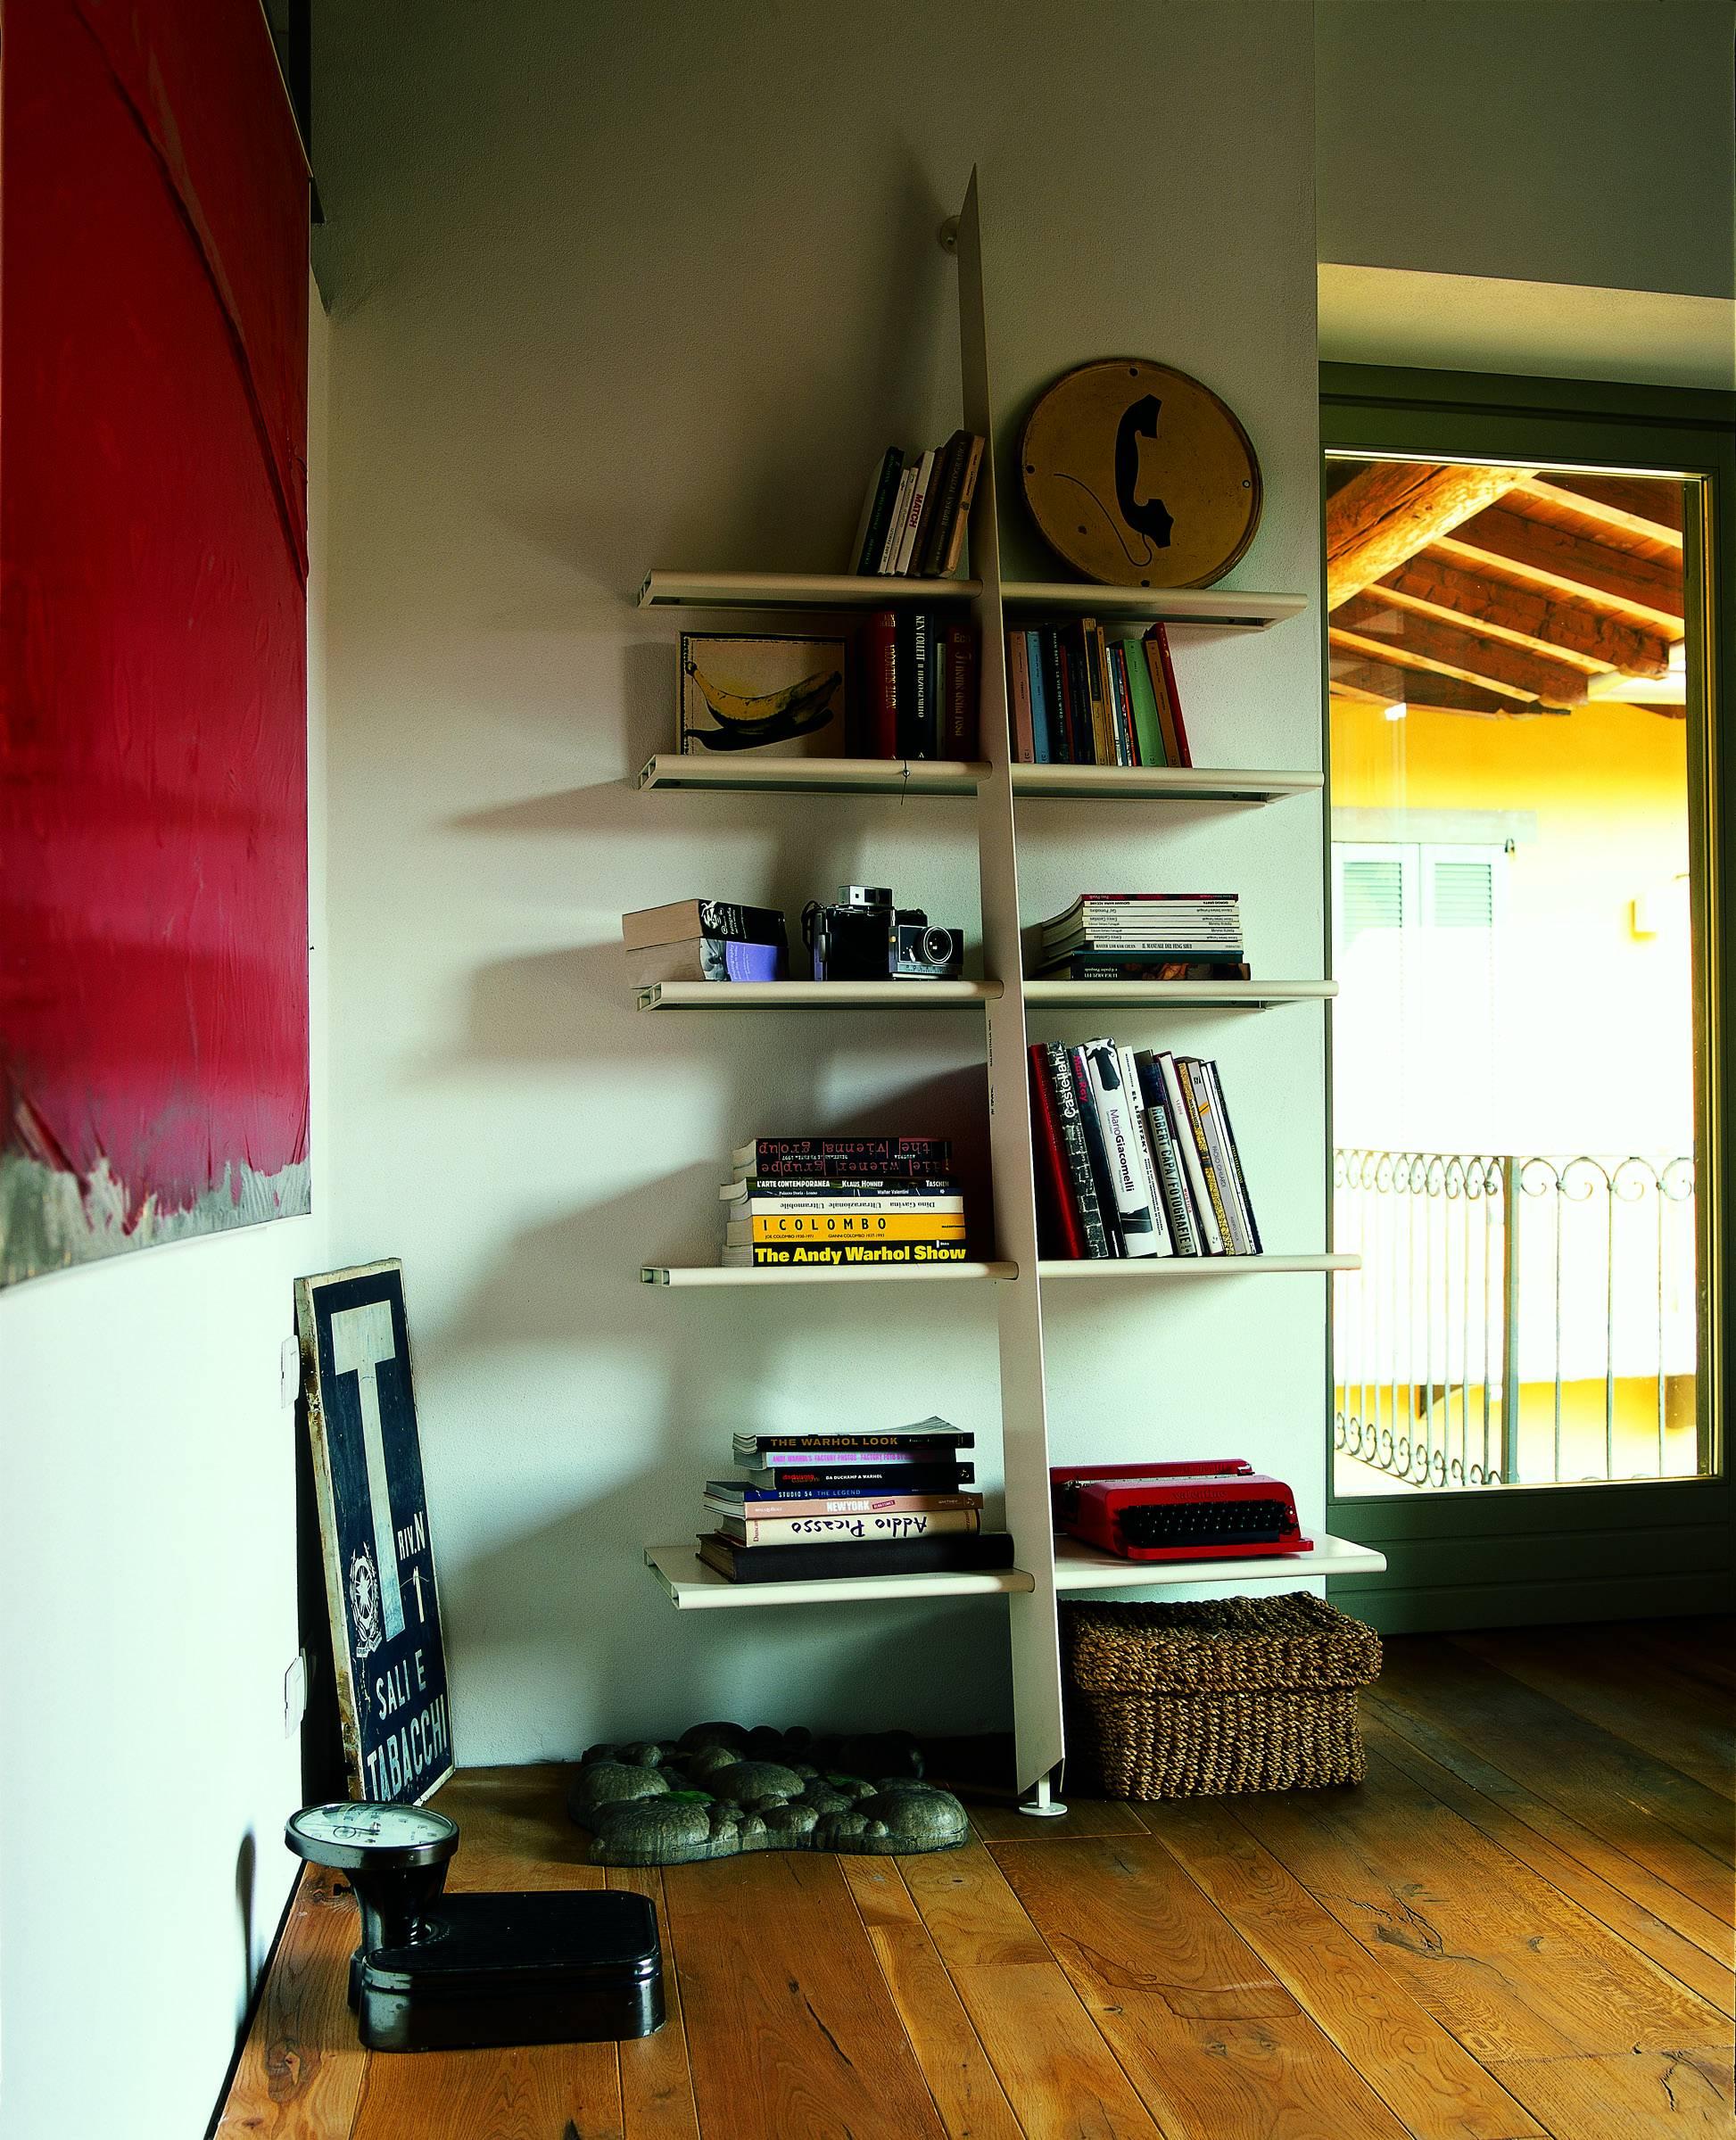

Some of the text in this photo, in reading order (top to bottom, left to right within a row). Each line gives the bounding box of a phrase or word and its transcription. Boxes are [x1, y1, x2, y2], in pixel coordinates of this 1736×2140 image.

[909, 493, 923, 528] MATCH
[915, 615, 925, 630] KEN
[915, 632, 925, 661] FOLLETT
[1073, 1055, 1088, 1103] Man Ray
[1134, 1105, 1148, 1153] LISSITZKY
[759, 1141, 811, 1153] group
[825, 1143, 887, 1155] vienna
[761, 1161, 823, 1172] gruppe
[839, 1161, 900, 1173] wiener
[1152, 1107, 1170, 1146] ROBERT
[1161, 1148, 1175, 1176] CAPA
[1168, 1182, 1192, 1244] FOTOGRAFIE
[779, 1218, 886, 1230] COLOMBO
[755, 1245, 966, 1265] The Andy Warhol Show
[801, 1438, 859, 1446] WARHOL
[863, 1437, 898, 1445] LOOK
[791, 1516, 927, 1537] Addio Picasso
[376, 1649, 426, 1720] SALI E
[368, 1694, 447, 1801] TABACCHI
